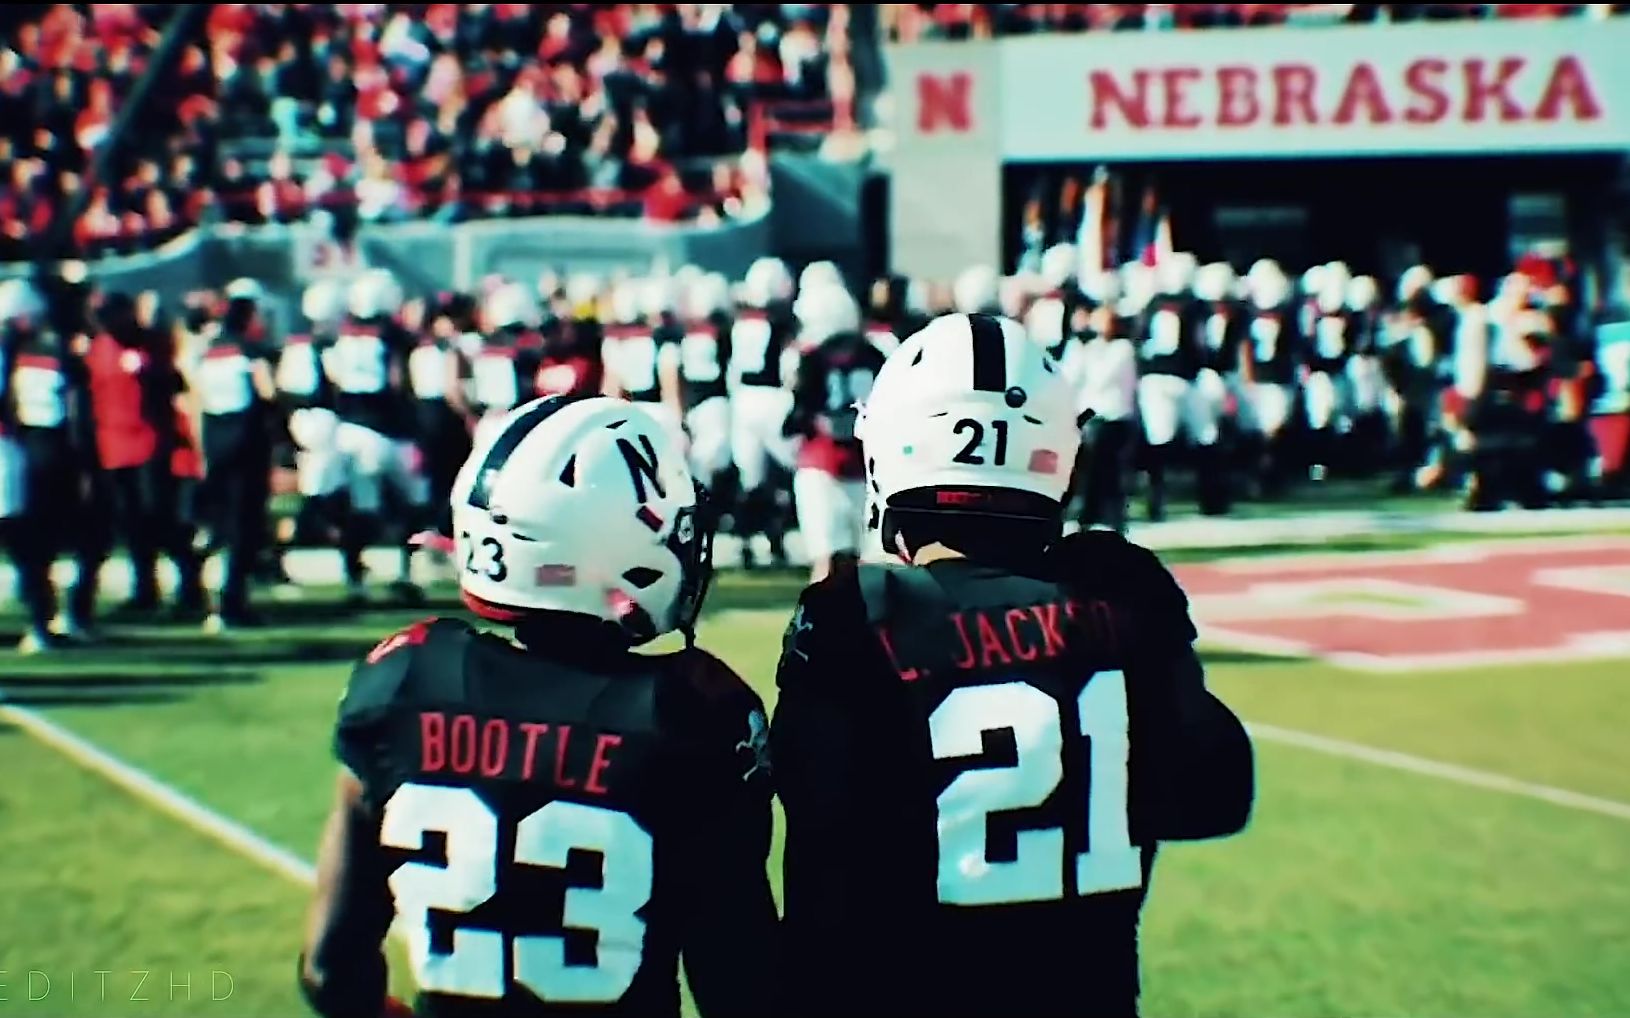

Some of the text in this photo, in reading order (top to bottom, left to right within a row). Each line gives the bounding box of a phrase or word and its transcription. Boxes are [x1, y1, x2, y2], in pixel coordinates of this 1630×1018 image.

[917, 72, 972, 133] N
[1089, 55, 1602, 130] NEBRASKA
[616, 434, 666, 504] N
[953, 418, 1008, 466] 21
[419, 711, 622, 794] BOOTLE
[928, 669, 1142, 907] 21
[381, 782, 654, 1004] 23
